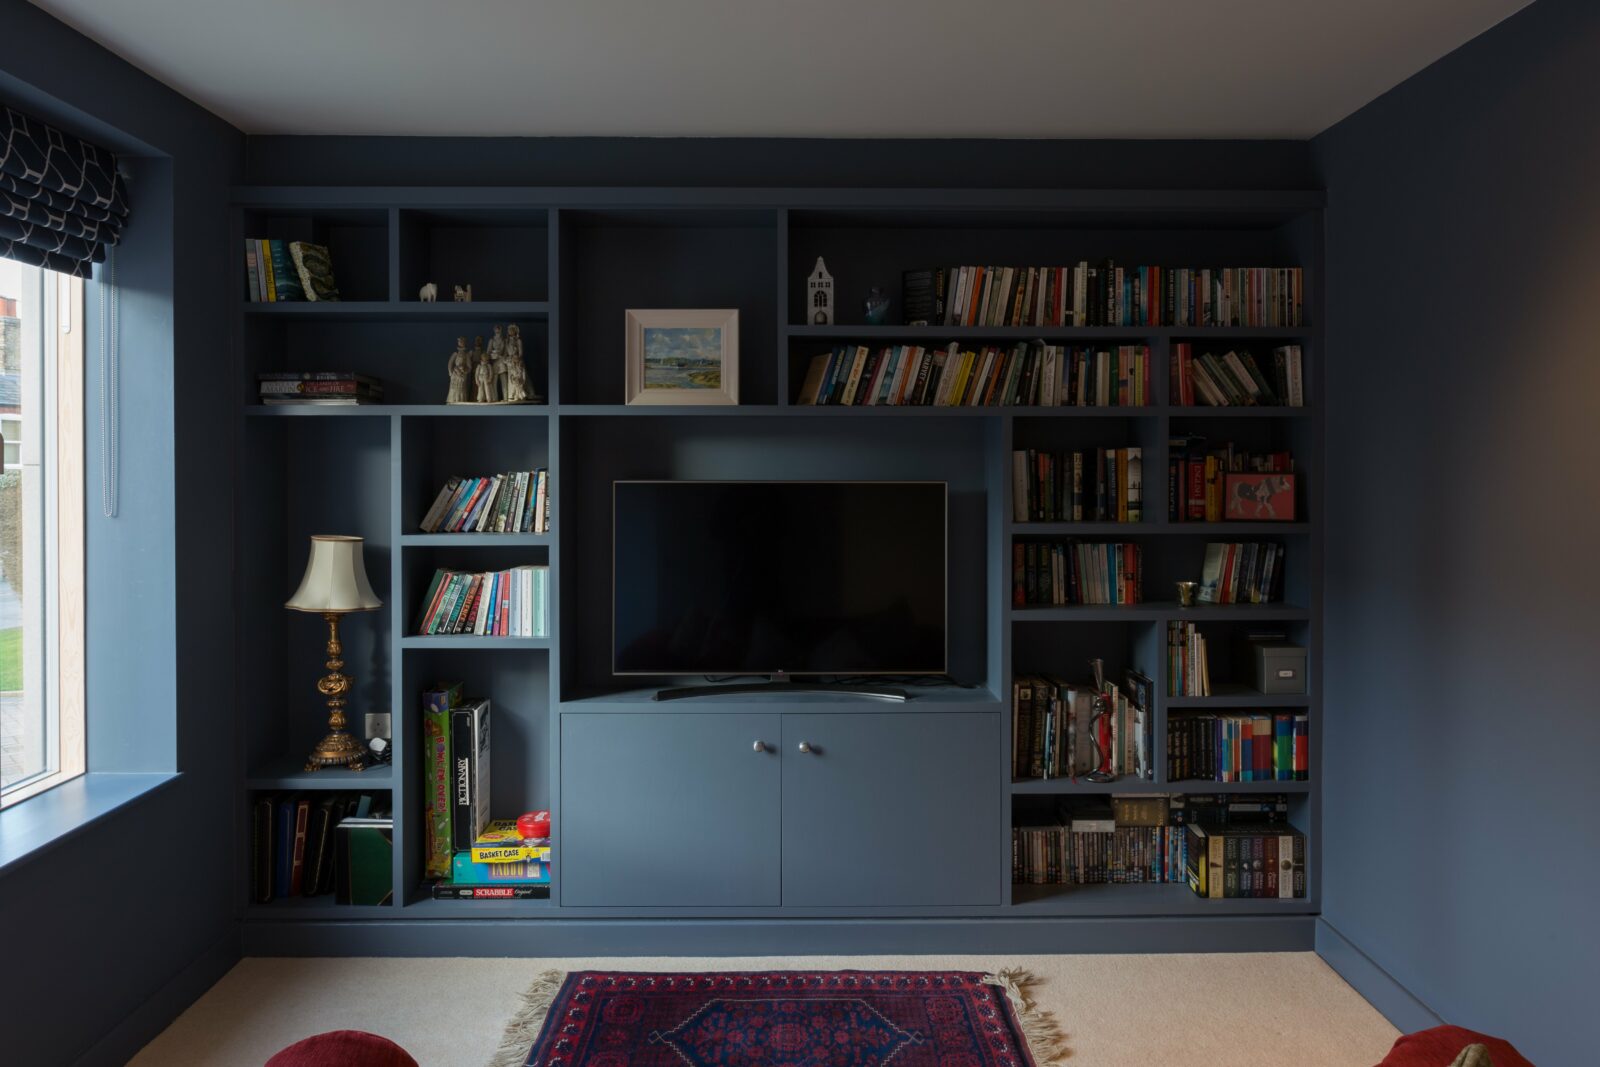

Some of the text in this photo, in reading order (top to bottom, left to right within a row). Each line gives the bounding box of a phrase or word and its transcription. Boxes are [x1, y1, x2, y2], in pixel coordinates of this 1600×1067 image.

[458, 756, 467, 806] PICTIONARY
[479, 848, 520, 860] BASKET CASE
[475, 888, 513, 897] SCRABBLE
